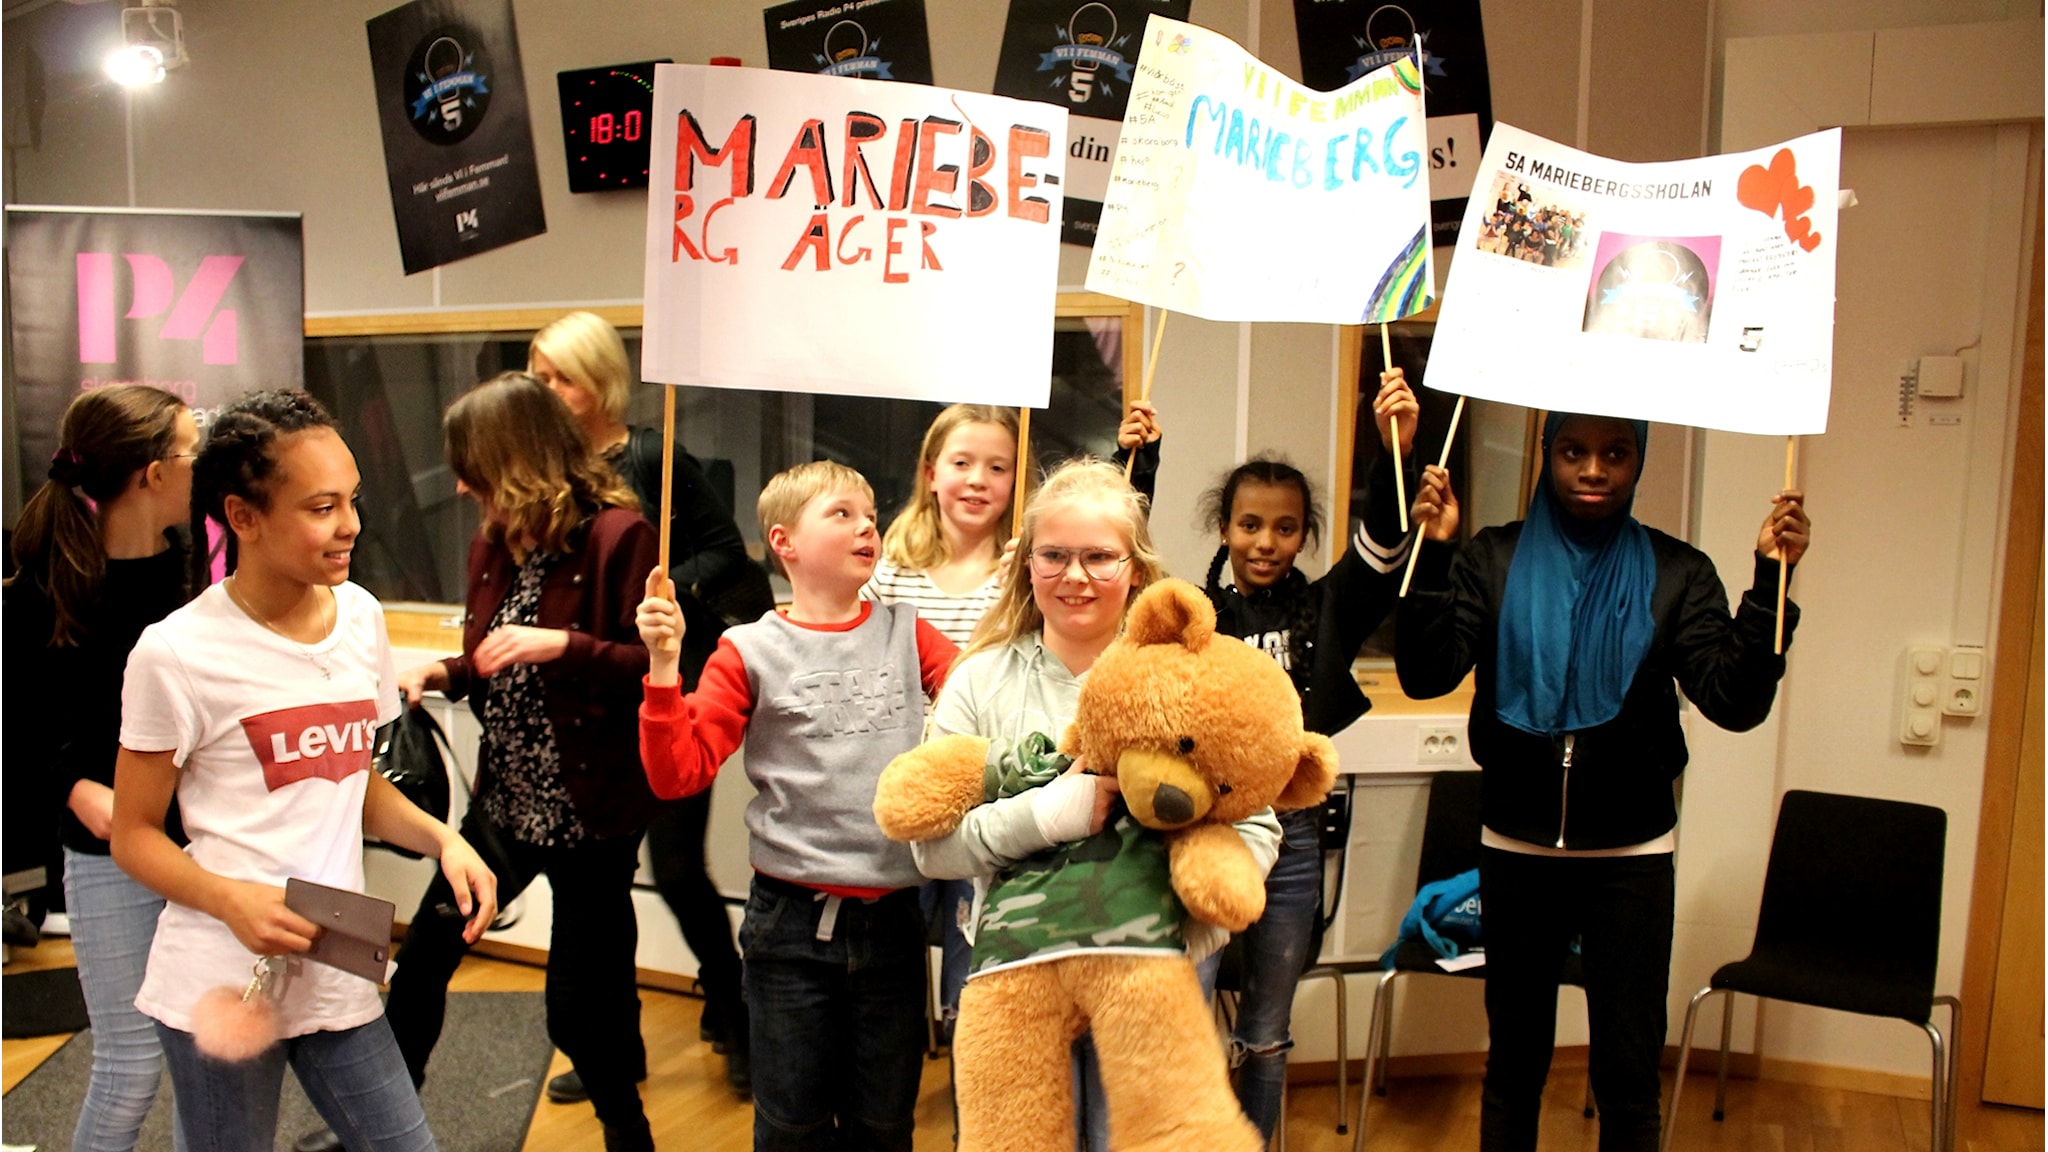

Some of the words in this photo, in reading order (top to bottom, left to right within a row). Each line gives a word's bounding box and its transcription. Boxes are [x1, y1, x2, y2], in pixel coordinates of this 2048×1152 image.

[817, 7, 842, 19] Radio
[843, 2, 856, 12] P4
[1056, 48, 1068, 57] VI
[1077, 48, 1120, 65] FEMMAN
[1068, 71, 1095, 103] 5
[1288, 77, 1399, 123] FEMMAN
[441, 99, 463, 131] 5
[1070, 135, 1109, 162] din
[1186, 94, 1420, 191] MARIEBERG
[1529, 159, 1713, 200] MARIEBERGSSKOLAN
[456, 208, 479, 233] P4
[672, 195, 738, 263] RG
[781, 205, 944, 284] ÄGER
[77, 252, 245, 365] P4
[1740, 326, 1764, 352] 5
[772, 664, 904, 710] STAR
